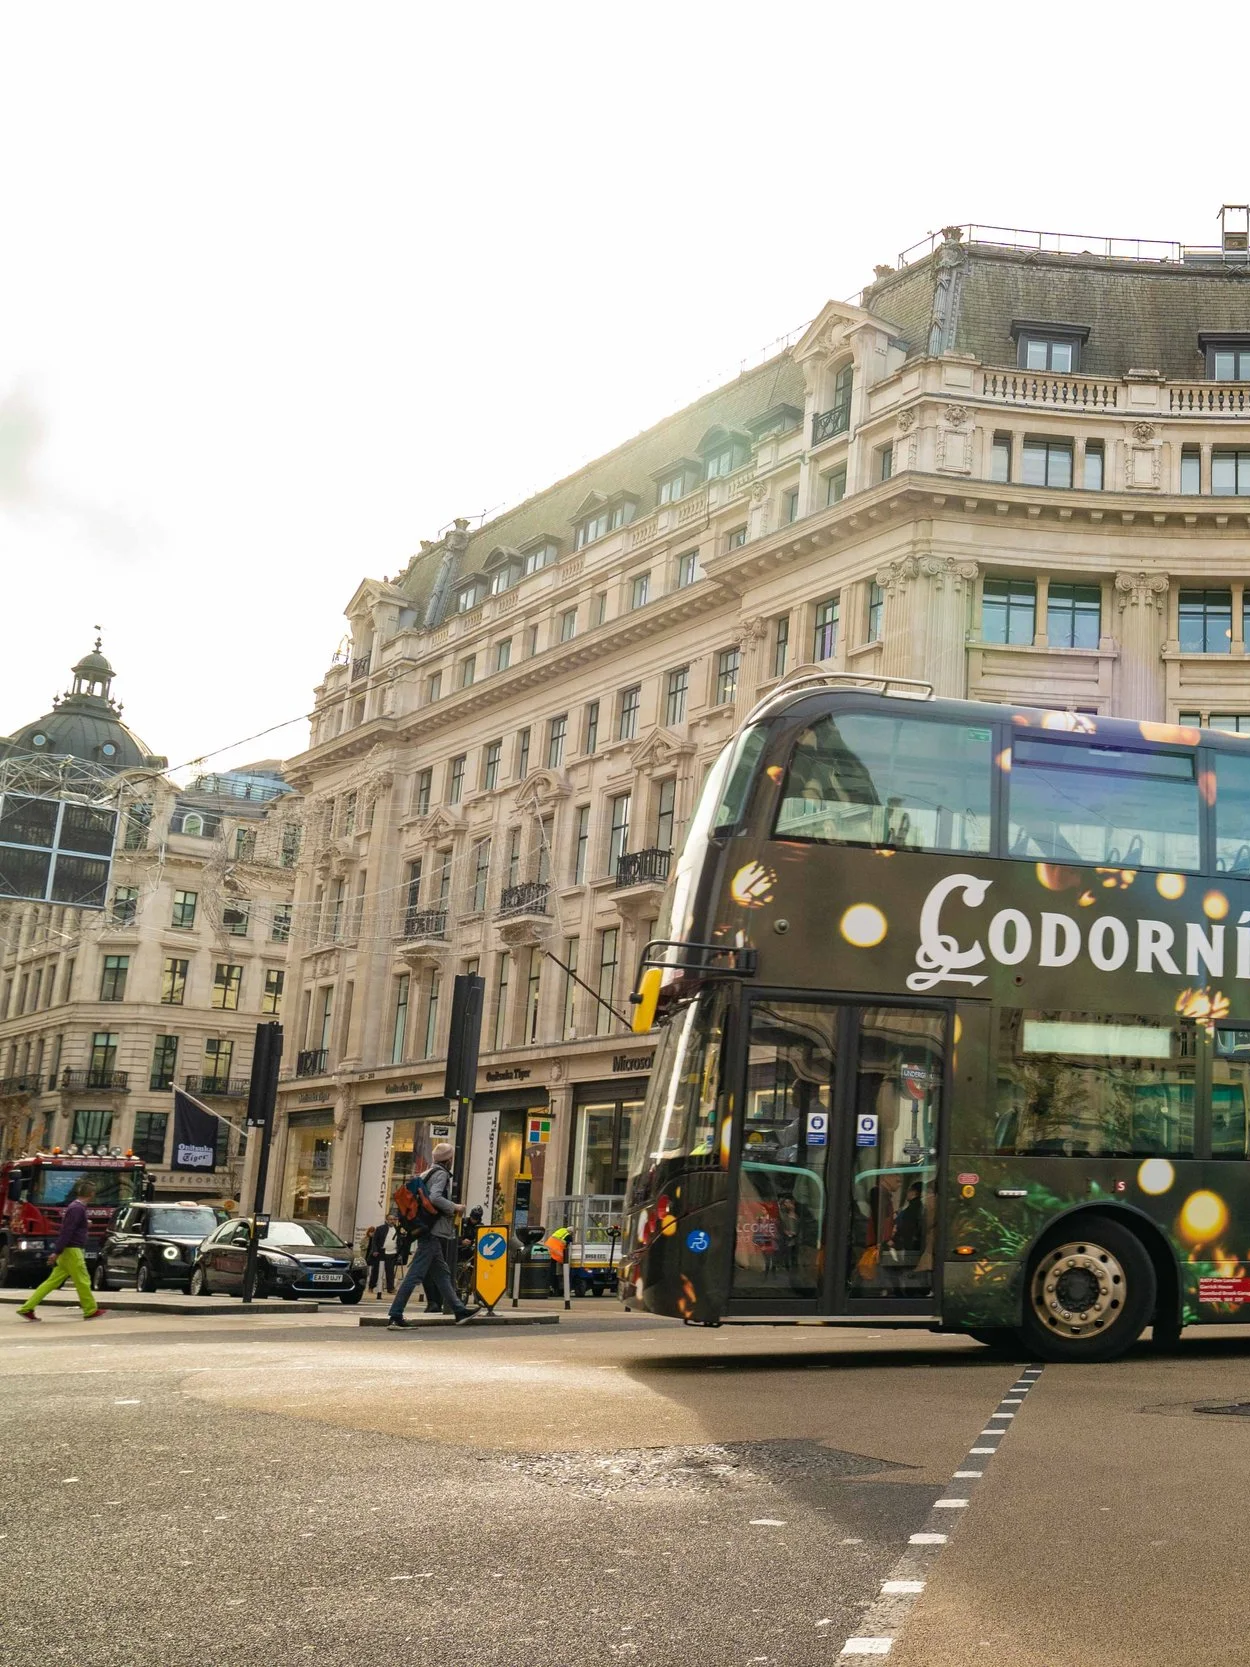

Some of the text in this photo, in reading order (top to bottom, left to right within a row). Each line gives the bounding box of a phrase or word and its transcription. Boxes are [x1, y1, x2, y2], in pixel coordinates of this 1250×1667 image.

[612, 1051, 655, 1072] Microsof
[904, 1070, 934, 1079] UNDERG
[736, 1223, 776, 1233] LCOME
